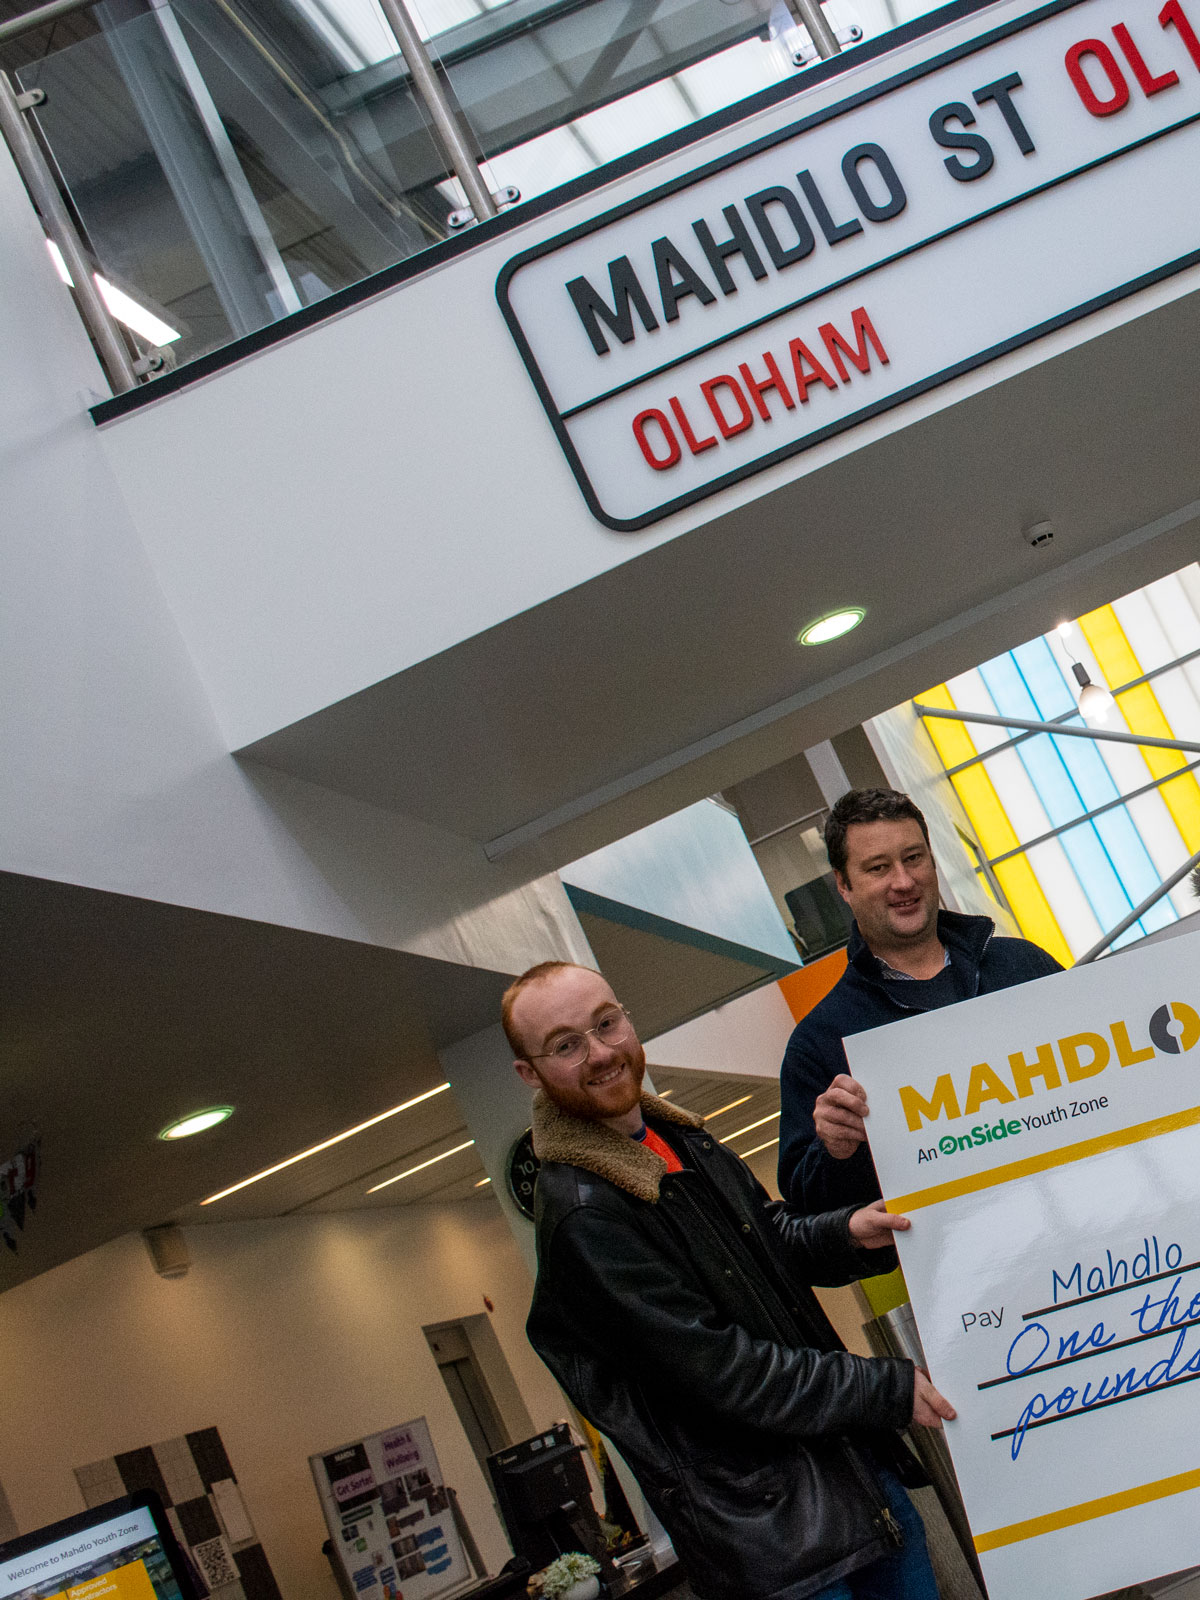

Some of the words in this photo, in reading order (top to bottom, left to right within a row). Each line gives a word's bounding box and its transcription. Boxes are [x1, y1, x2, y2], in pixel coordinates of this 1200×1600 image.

[565, 143, 908, 356] MAHDLO
[928, 71, 1036, 183] ST
[631, 306, 891, 471] OLDHAM
[917, 1145, 939, 1164] An
[939, 1117, 1022, 1156] OnSide
[1021, 1104, 1068, 1132] Youth
[1070, 1095, 1109, 1119] Zone
[518, 1160, 535, 1176] 10
[521, 1181, 533, 1195] 9
[1052, 1236, 1183, 1303] Mahdlo
[961, 1306, 1006, 1333] Pay
[1006, 1323, 1117, 1376] One
[7, 1561, 49, 1581] Welcome
[50, 1555, 60, 1565] to
[60, 1543, 92, 1561] Mahdlo
[92, 1532, 118, 1547] Youth
[118, 1523, 139, 1537] Zone
[71, 1576, 108, 1598] Approved
